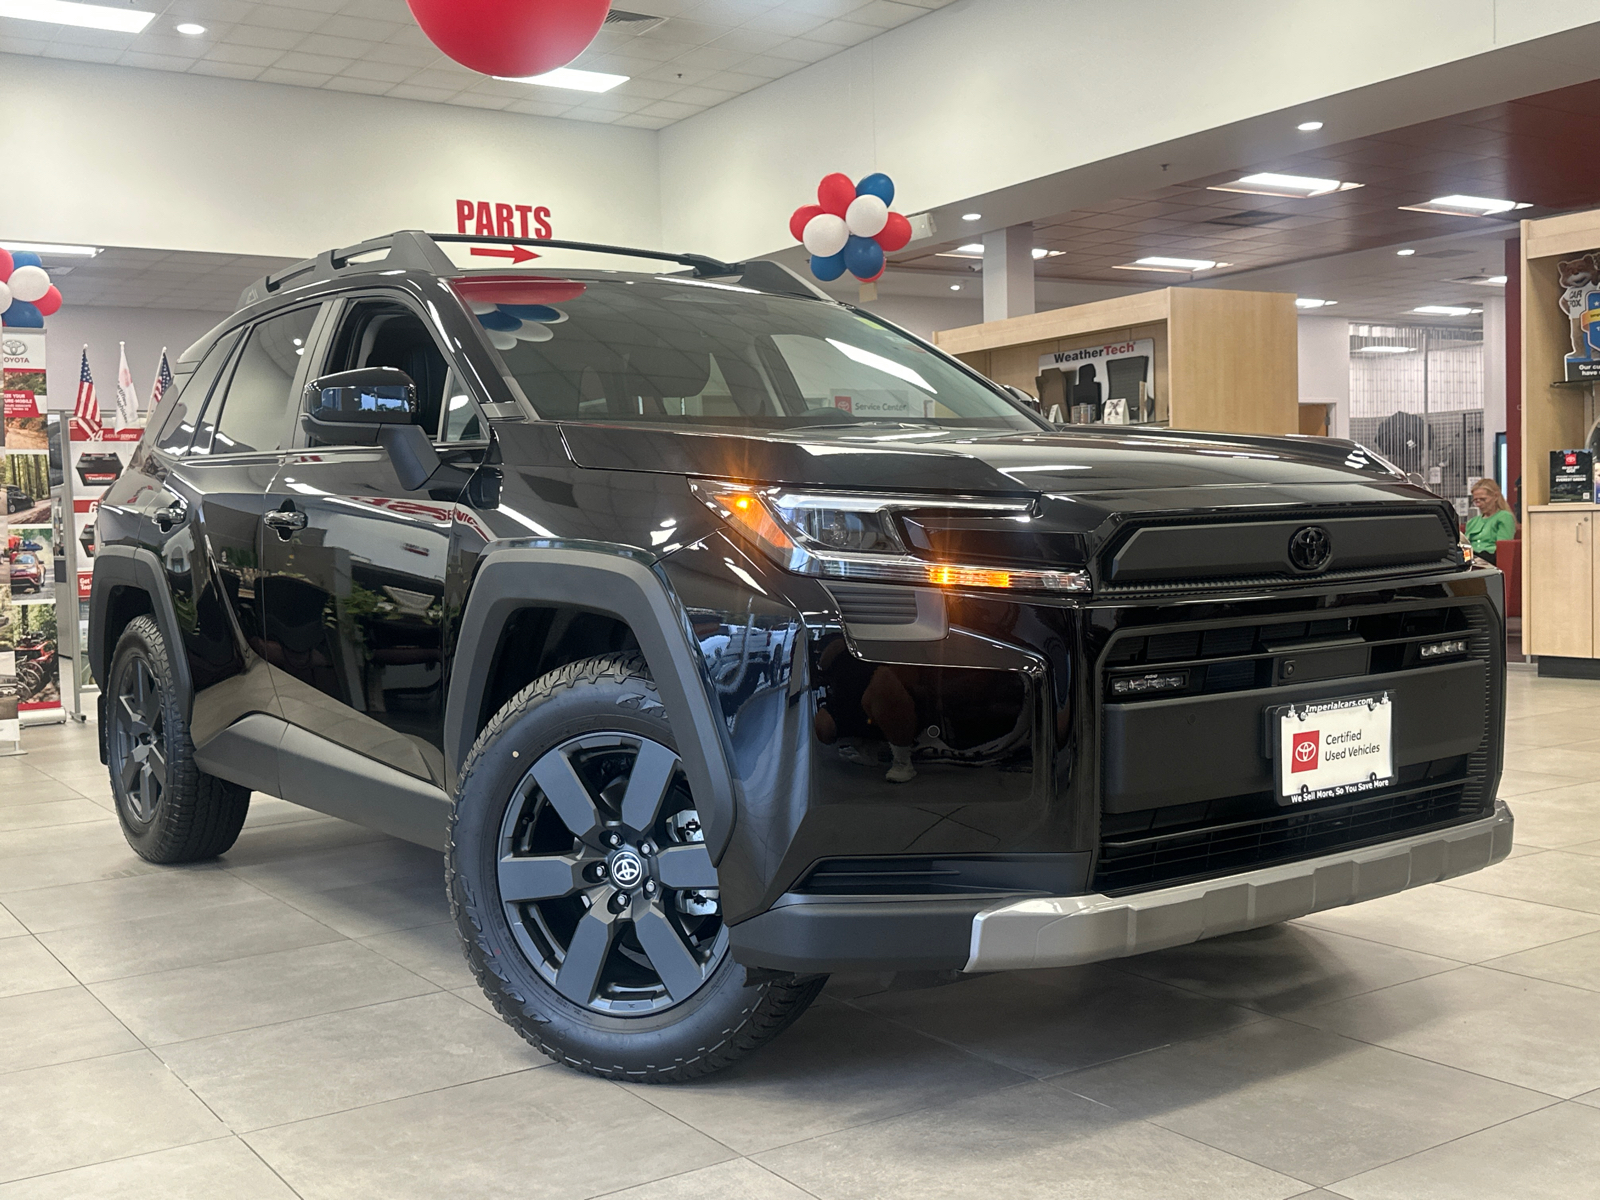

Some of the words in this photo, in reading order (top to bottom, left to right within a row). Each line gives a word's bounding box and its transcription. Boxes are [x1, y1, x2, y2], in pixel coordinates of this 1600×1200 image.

[456, 199, 553, 240] PARTS
[3, 356, 30, 364] OYOTA
[1054, 342, 1134, 364] WeatherTech
[855, 402, 881, 411] Service
[883, 402, 907, 411] Center
[1305, 697, 1374, 714] Imperialcars.com
[1325, 729, 1362, 745] Certified
[1324, 747, 1346, 762] Used
[1348, 743, 1380, 758] Vehicles
[1291, 794, 1302, 804] We
[1302, 791, 1316, 802] Sell
[1316, 789, 1335, 800] More,
[1335, 787, 1344, 796] So
[1345, 785, 1357, 794] You
[1358, 782, 1373, 792] Save
[1373, 779, 1389, 789] More
